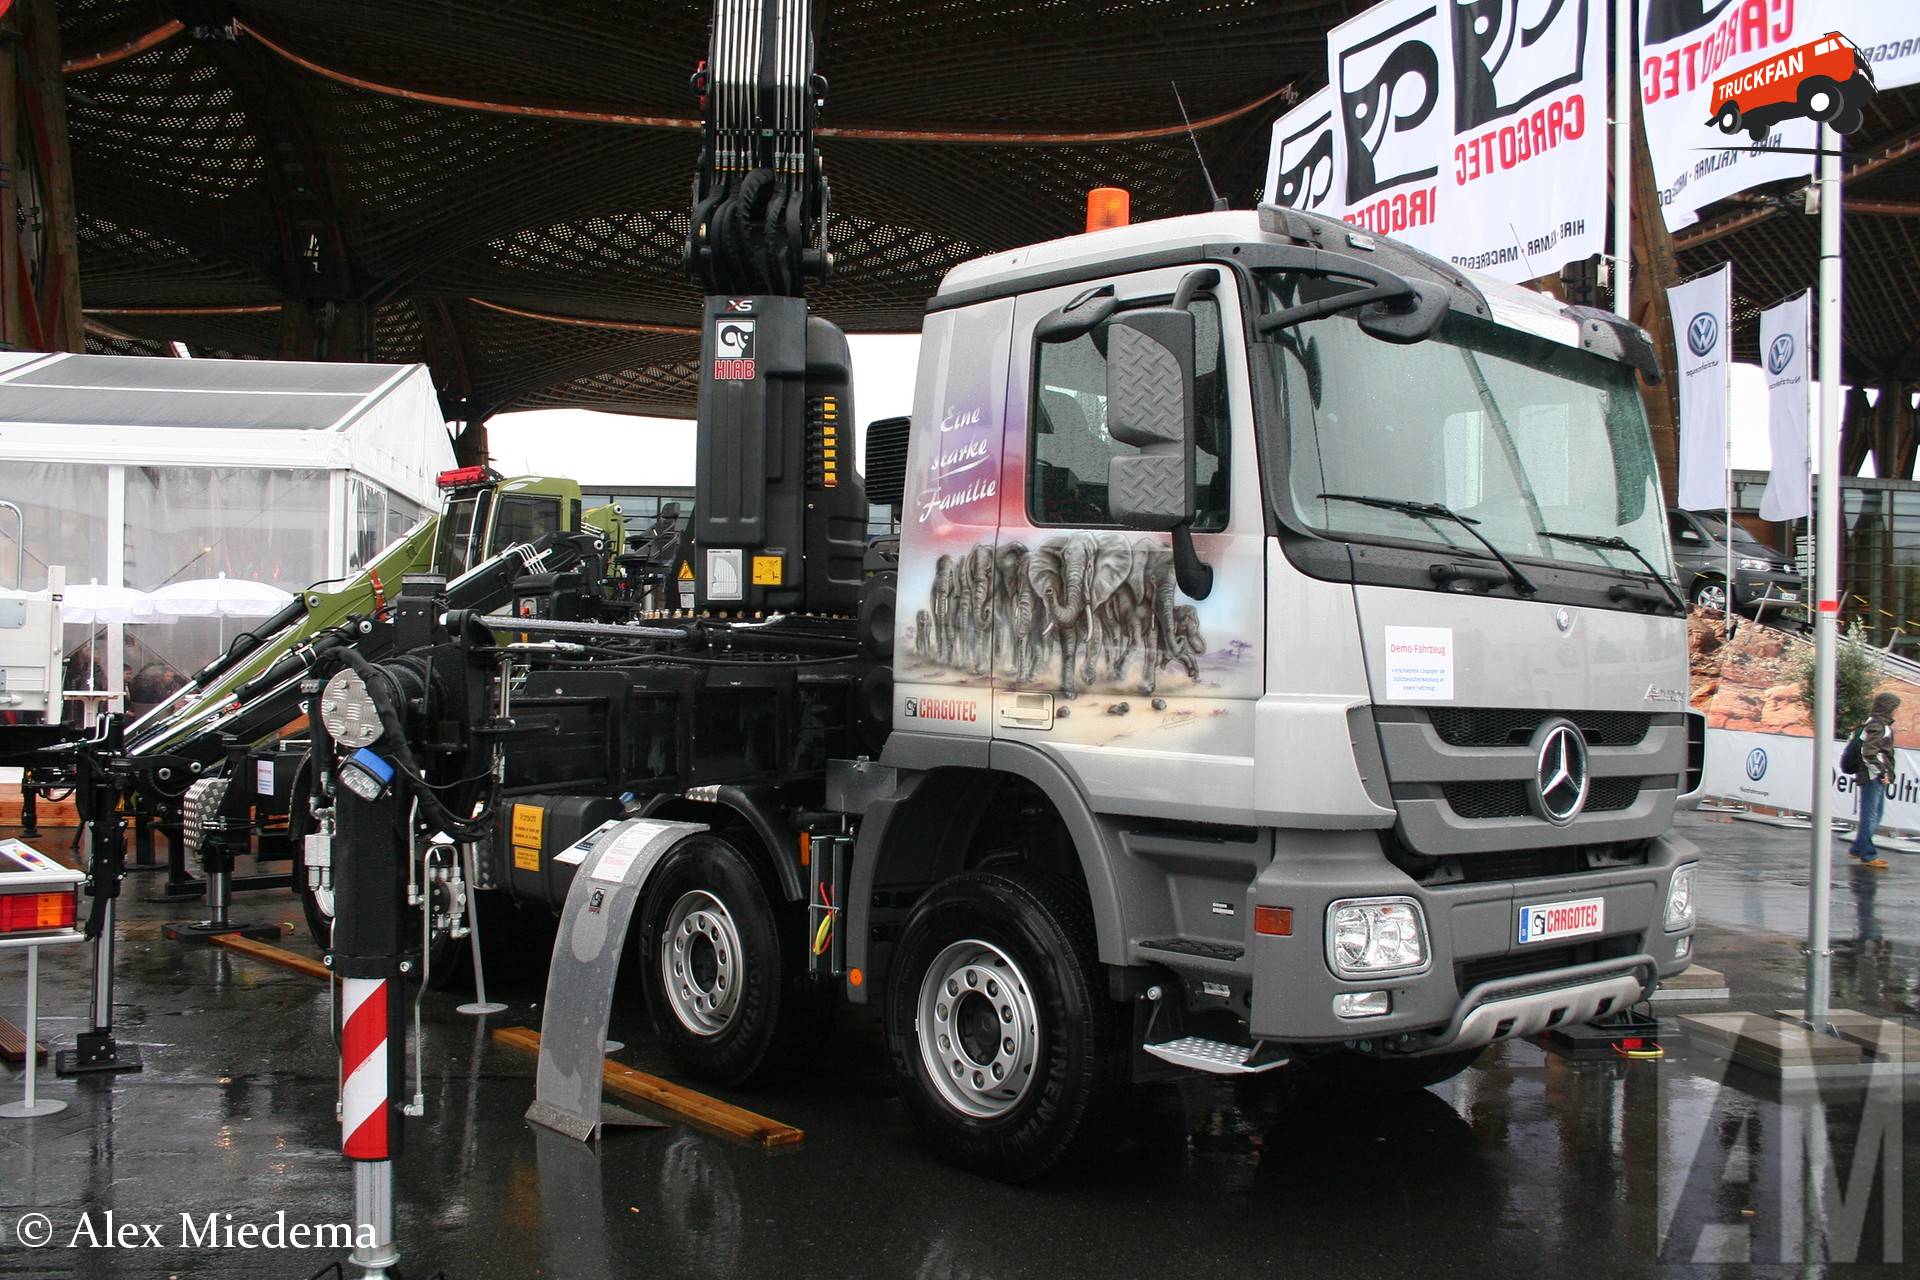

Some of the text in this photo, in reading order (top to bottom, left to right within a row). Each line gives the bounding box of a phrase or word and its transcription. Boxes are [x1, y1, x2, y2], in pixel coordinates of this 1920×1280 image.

[725, 299, 753, 312] XS
[714, 360, 756, 380] HIAB
[940, 405, 980, 432] Eine
[918, 479, 996, 523] Familie
[1390, 643, 1446, 656] Demo-Fahrzeug
[919, 697, 976, 722] CARGOTEC
[1547, 904, 1597, 932] CARGOTEC
